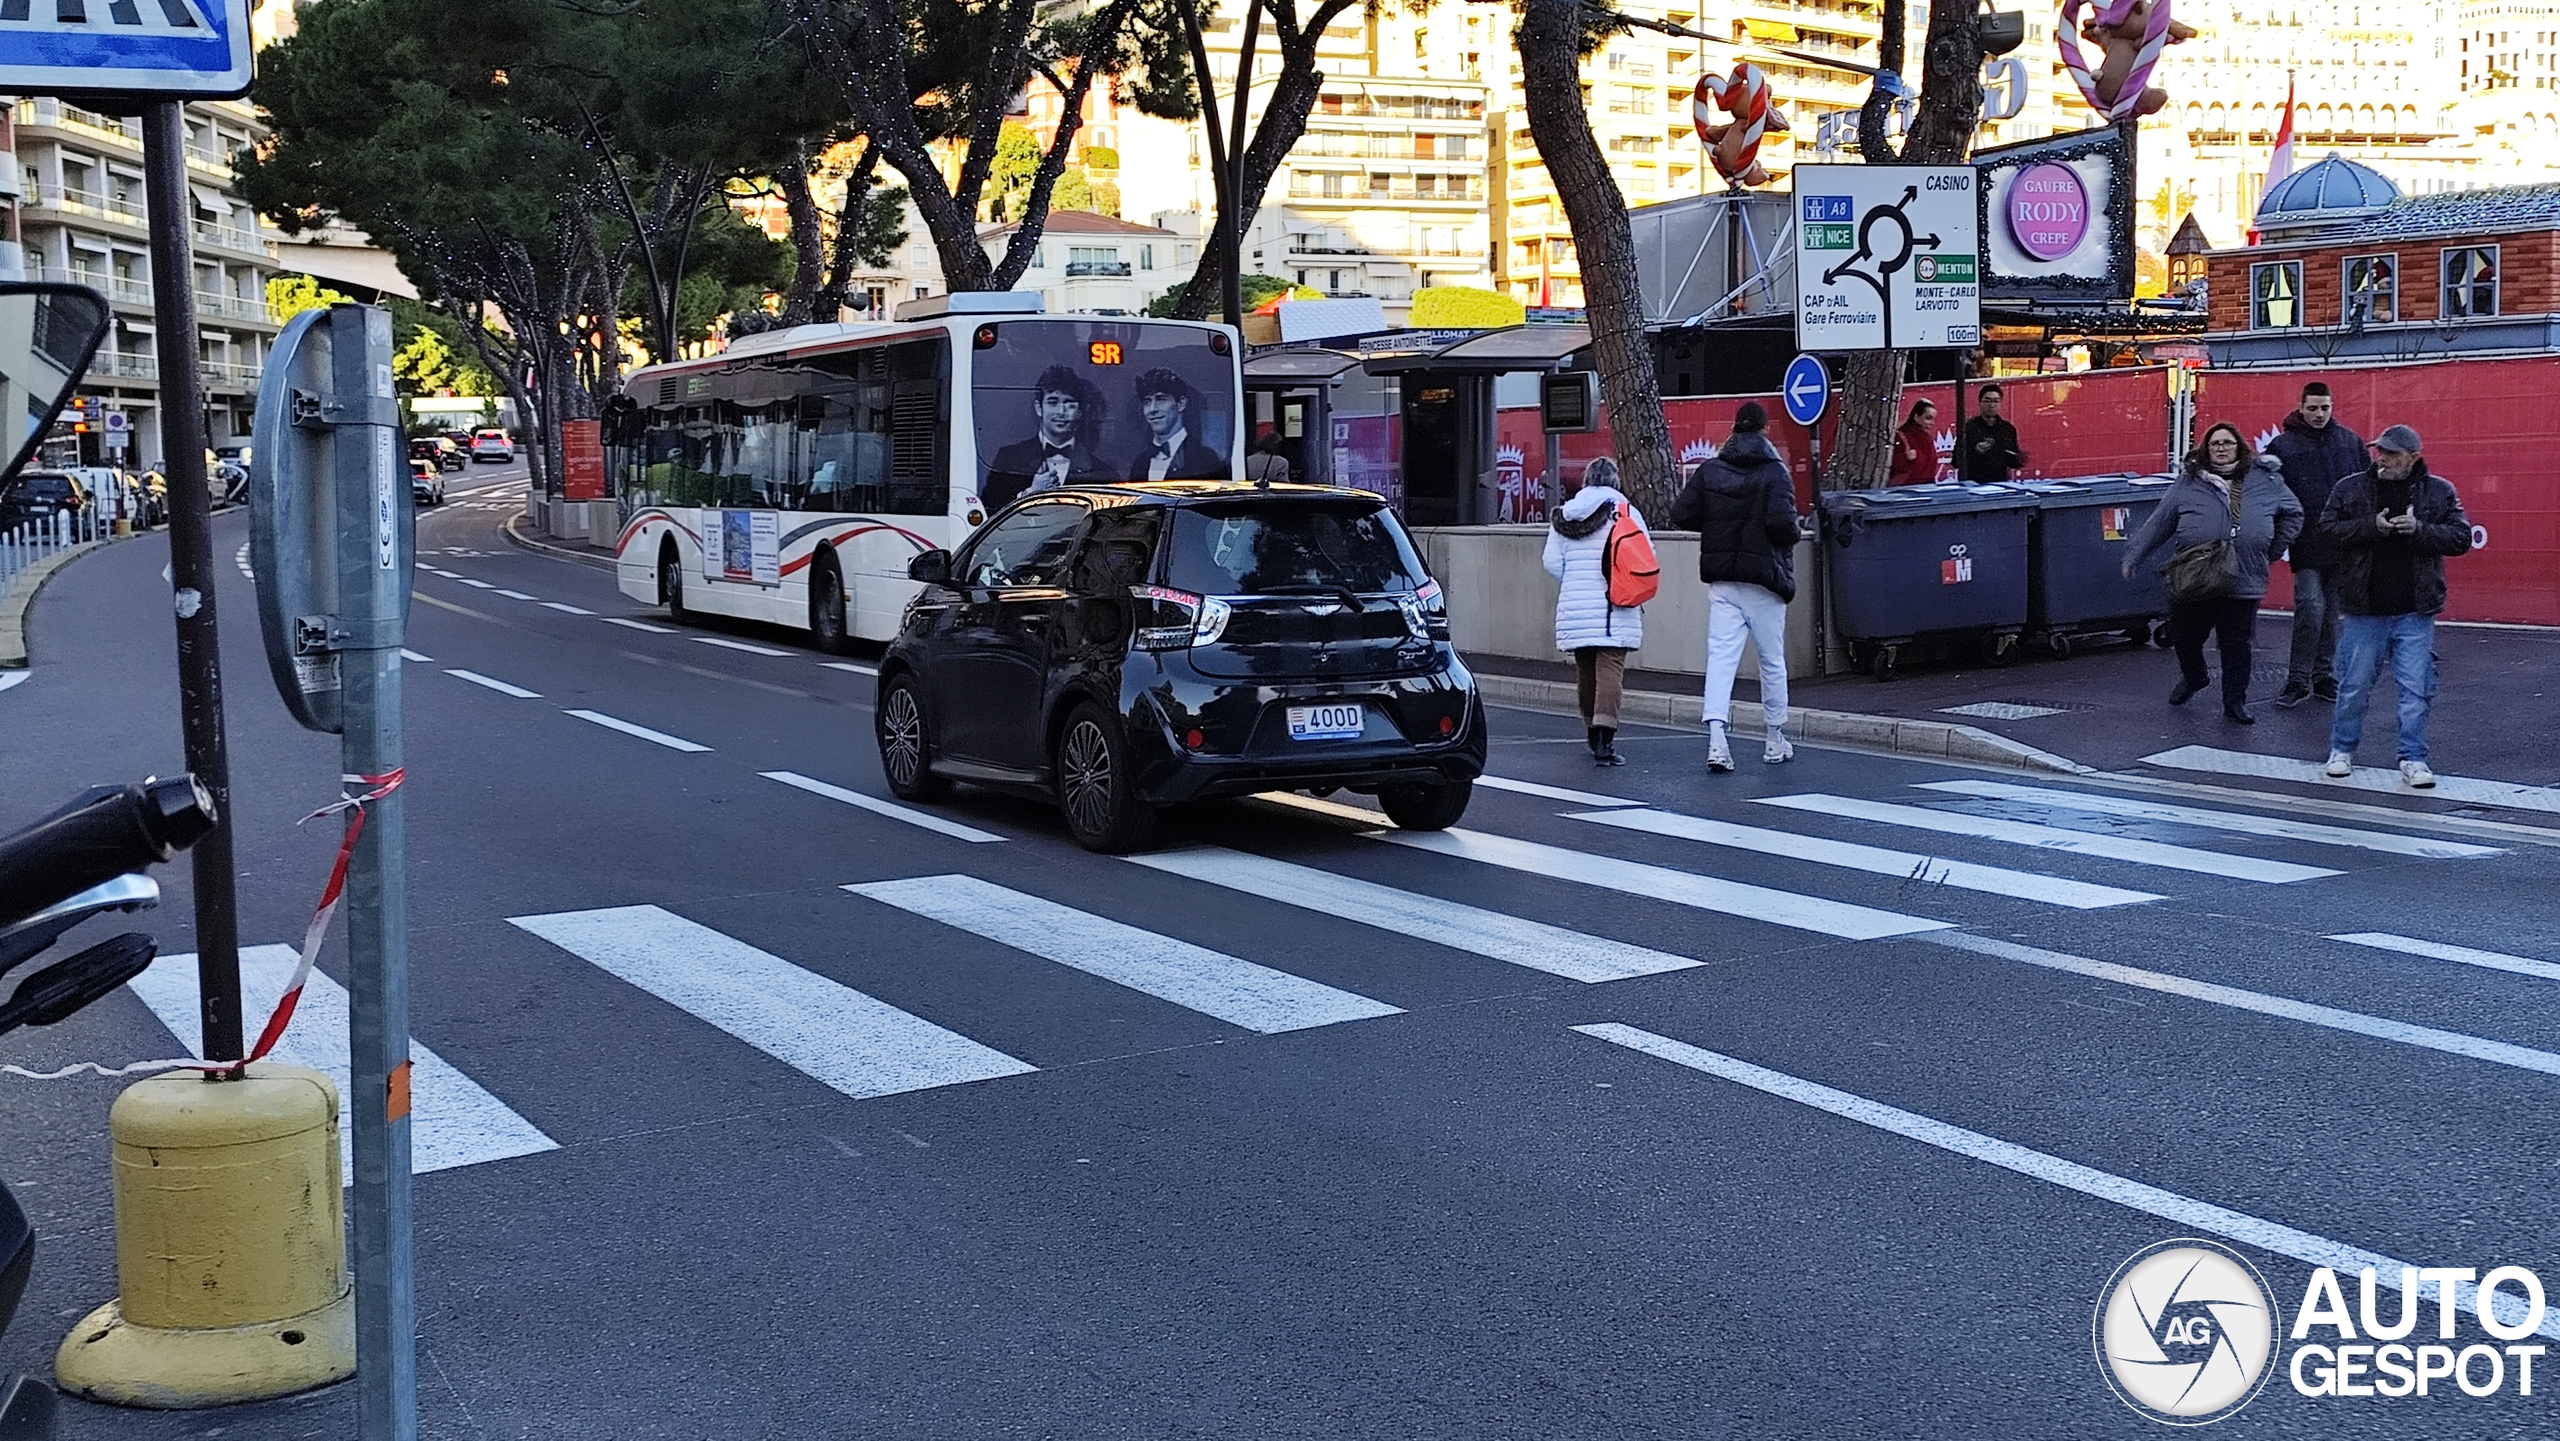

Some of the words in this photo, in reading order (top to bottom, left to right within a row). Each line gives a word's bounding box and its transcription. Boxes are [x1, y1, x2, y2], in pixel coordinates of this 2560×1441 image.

[1926, 175, 1970, 191] CASINO
[2024, 180, 2075, 193] GAUFRE
[1831, 202, 1847, 216] A8
[2018, 202, 2082, 222] RODY
[1827, 230, 1850, 244] NICE
[2030, 232, 2069, 244] CREPE
[1938, 263, 1973, 275] MENTON
[1915, 286, 1977, 298] MONTE-CARLO
[1804, 295, 1826, 308] CAP
[1915, 300, 1960, 311] LARVOTTO
[1804, 311, 1827, 325] Gare
[1828, 311, 1877, 324] Ferroviaire
[1950, 329, 1977, 340] 100m
[1360, 340, 1393, 351] PRINCESSE
[1394, 335, 1432, 349] ANTOINETTE
[1091, 343, 1120, 364] SR
[1310, 707, 1359, 728] 400D
